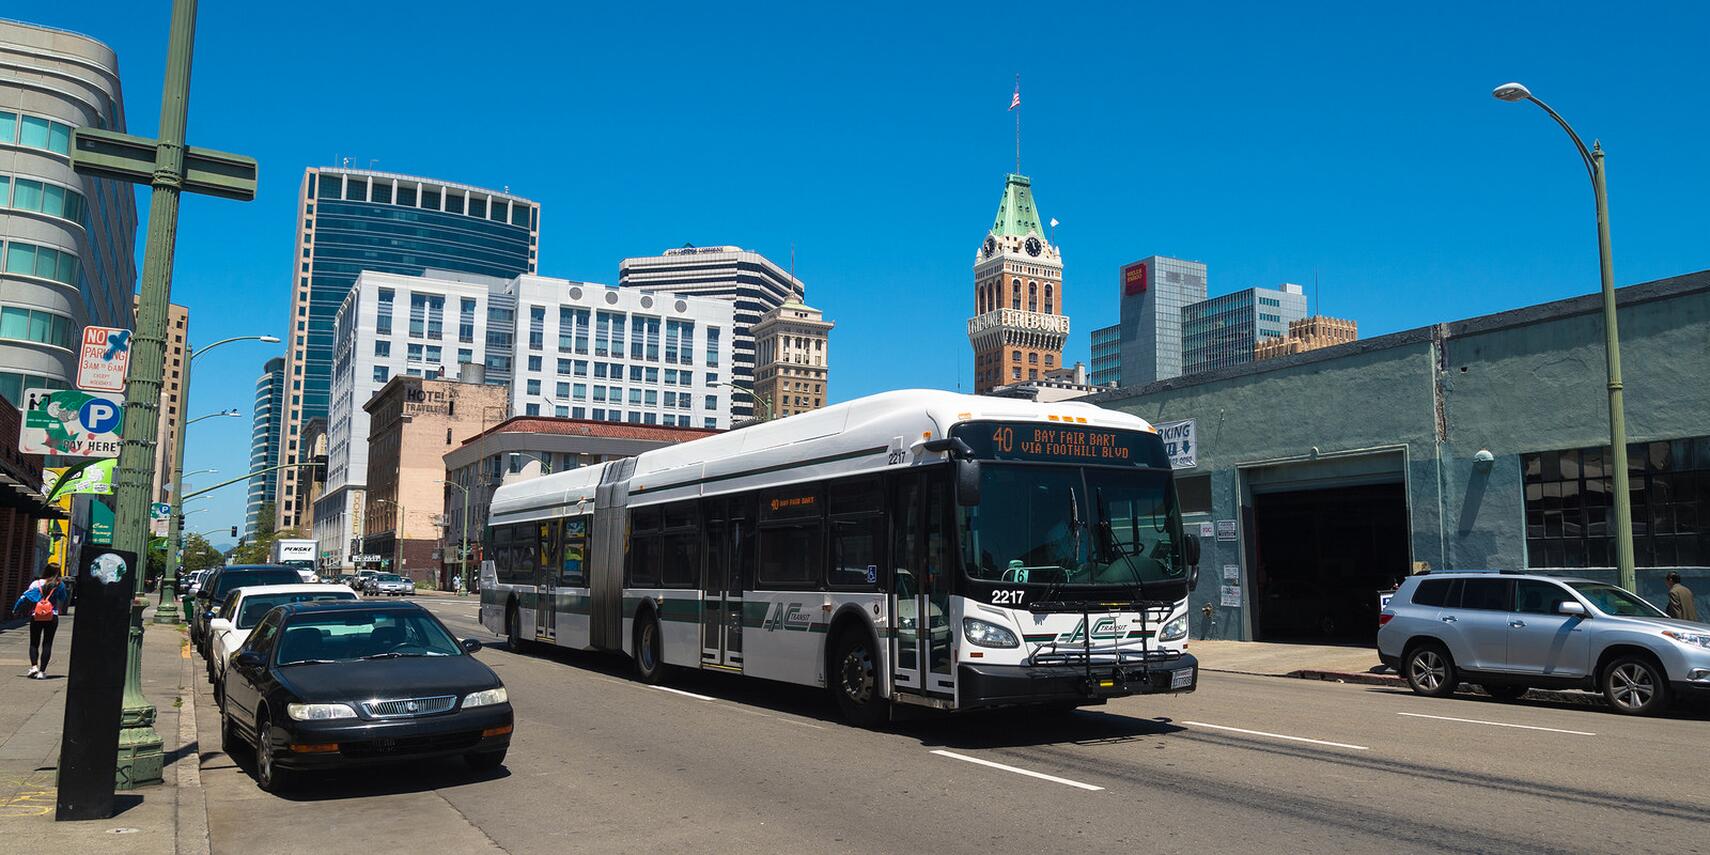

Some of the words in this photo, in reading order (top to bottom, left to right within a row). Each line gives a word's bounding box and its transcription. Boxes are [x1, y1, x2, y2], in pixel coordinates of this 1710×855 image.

[968, 311, 1001, 335] TRIBUNE
[1002, 308, 1069, 333] TRIBUNE
[87, 329, 106, 344] NO
[88, 404, 114, 429] P
[64, 440, 83, 451] PAY
[88, 441, 116, 452] HERE
[993, 427, 1013, 453] 40
[1034, 429, 1056, 442] BAY
[1060, 431, 1085, 445] FAIR
[1089, 433, 1116, 447] BART
[888, 451, 906, 465] 2217
[1021, 441, 1042, 454] VIA
[1046, 443, 1097, 457] FOOTHILL
[1102, 446, 1129, 459] BLVD
[991, 590, 1025, 604] 2217
[1100, 624, 1128, 632] TRANSIT
